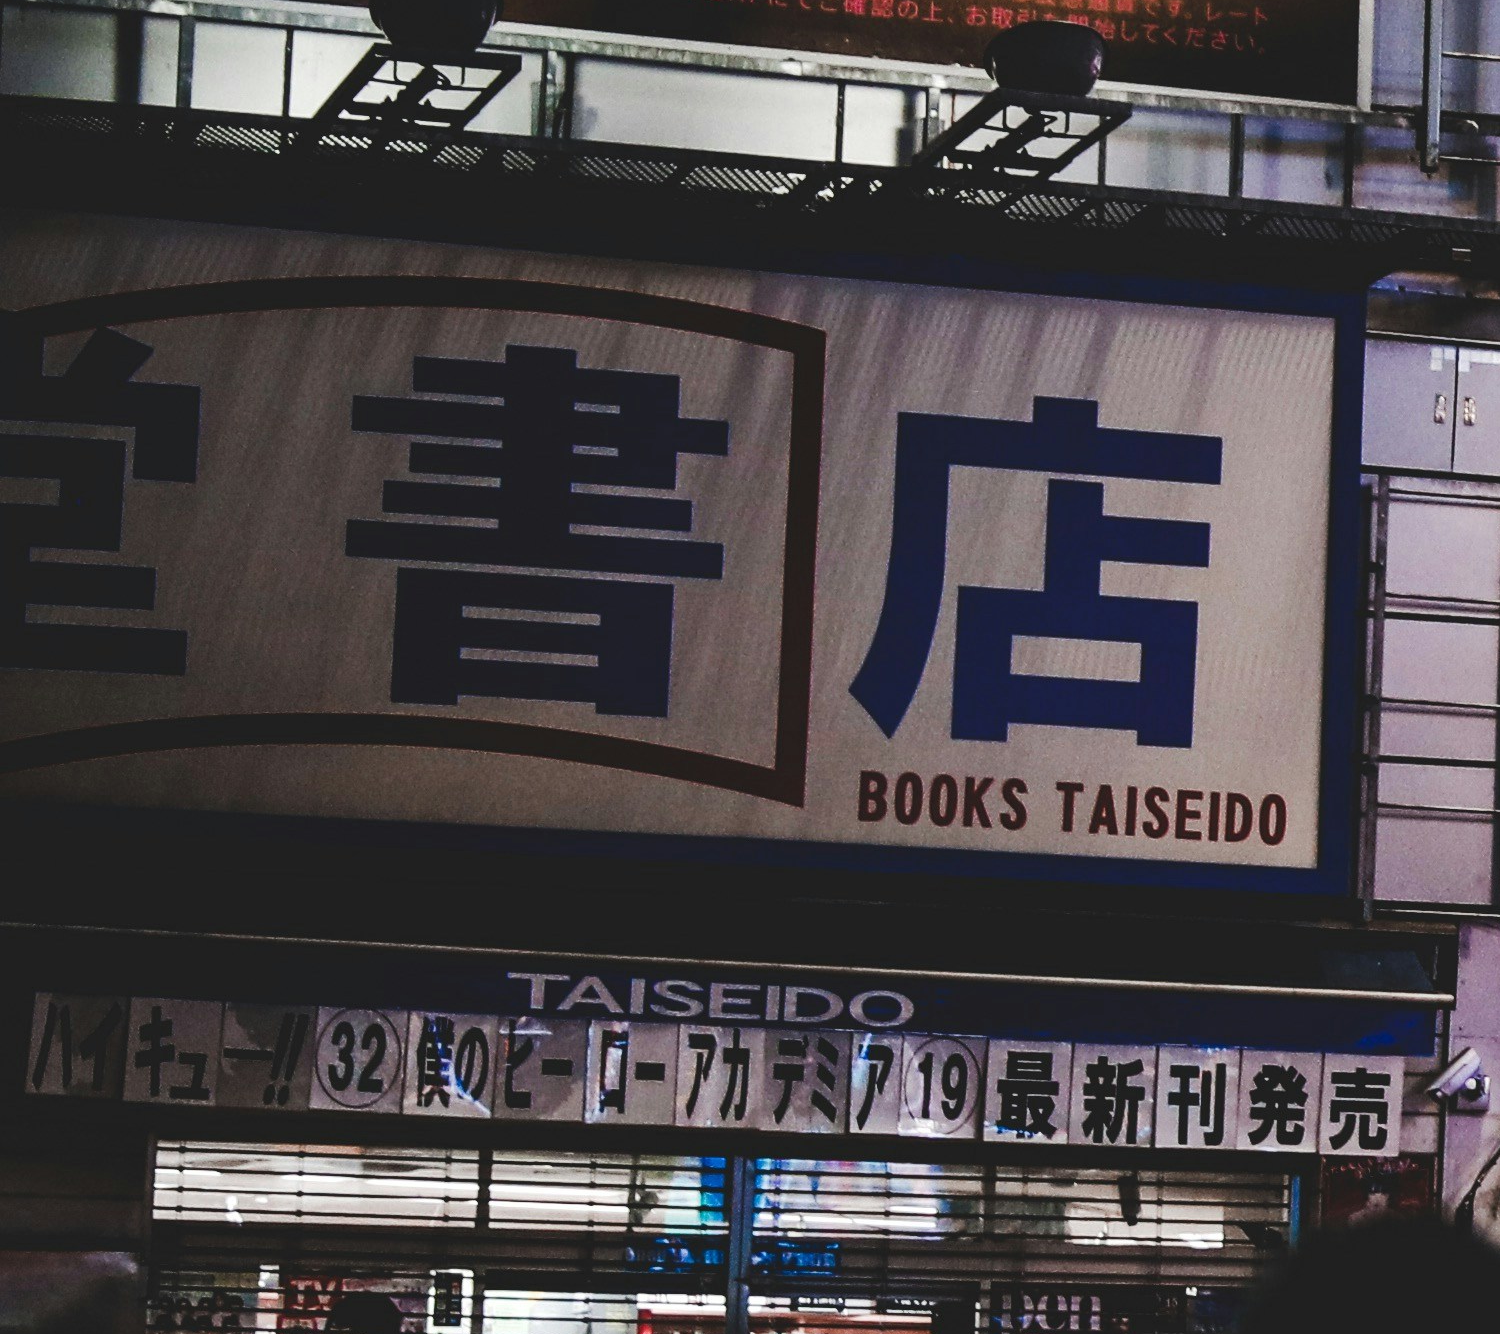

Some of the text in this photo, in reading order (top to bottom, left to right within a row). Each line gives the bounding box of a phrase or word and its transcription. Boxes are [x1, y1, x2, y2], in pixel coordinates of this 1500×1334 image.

[857, 769, 1289, 846] BOOKS TAISEIDO
[507, 970, 915, 1027] TAISEIDO
